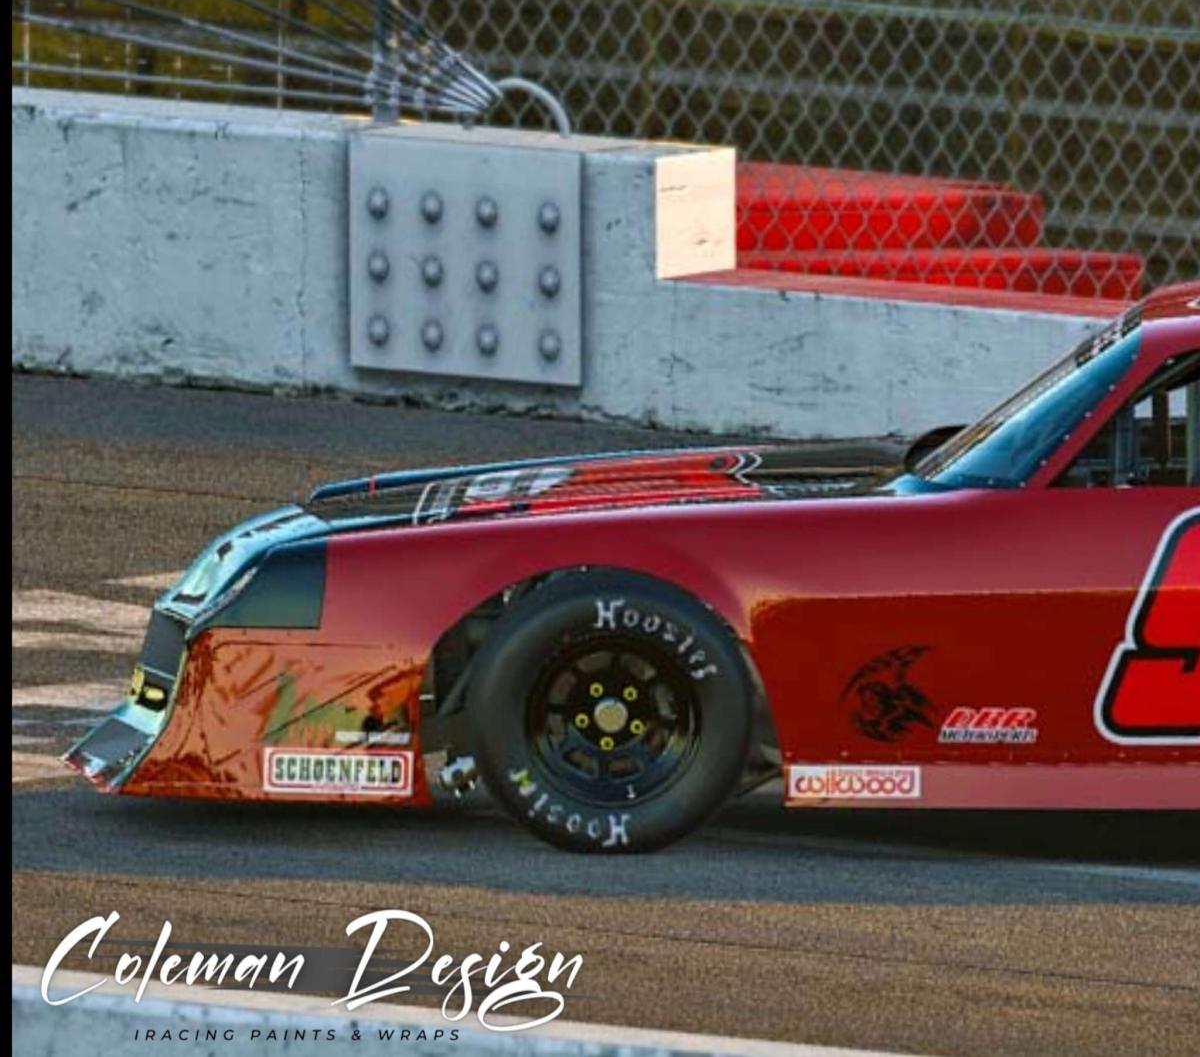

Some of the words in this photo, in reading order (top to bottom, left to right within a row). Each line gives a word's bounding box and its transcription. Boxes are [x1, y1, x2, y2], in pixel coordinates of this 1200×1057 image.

[593, 598, 718, 681] Hoosier
[944, 706, 1037, 729] DBR
[273, 756, 402, 784] SCHOENFELD
